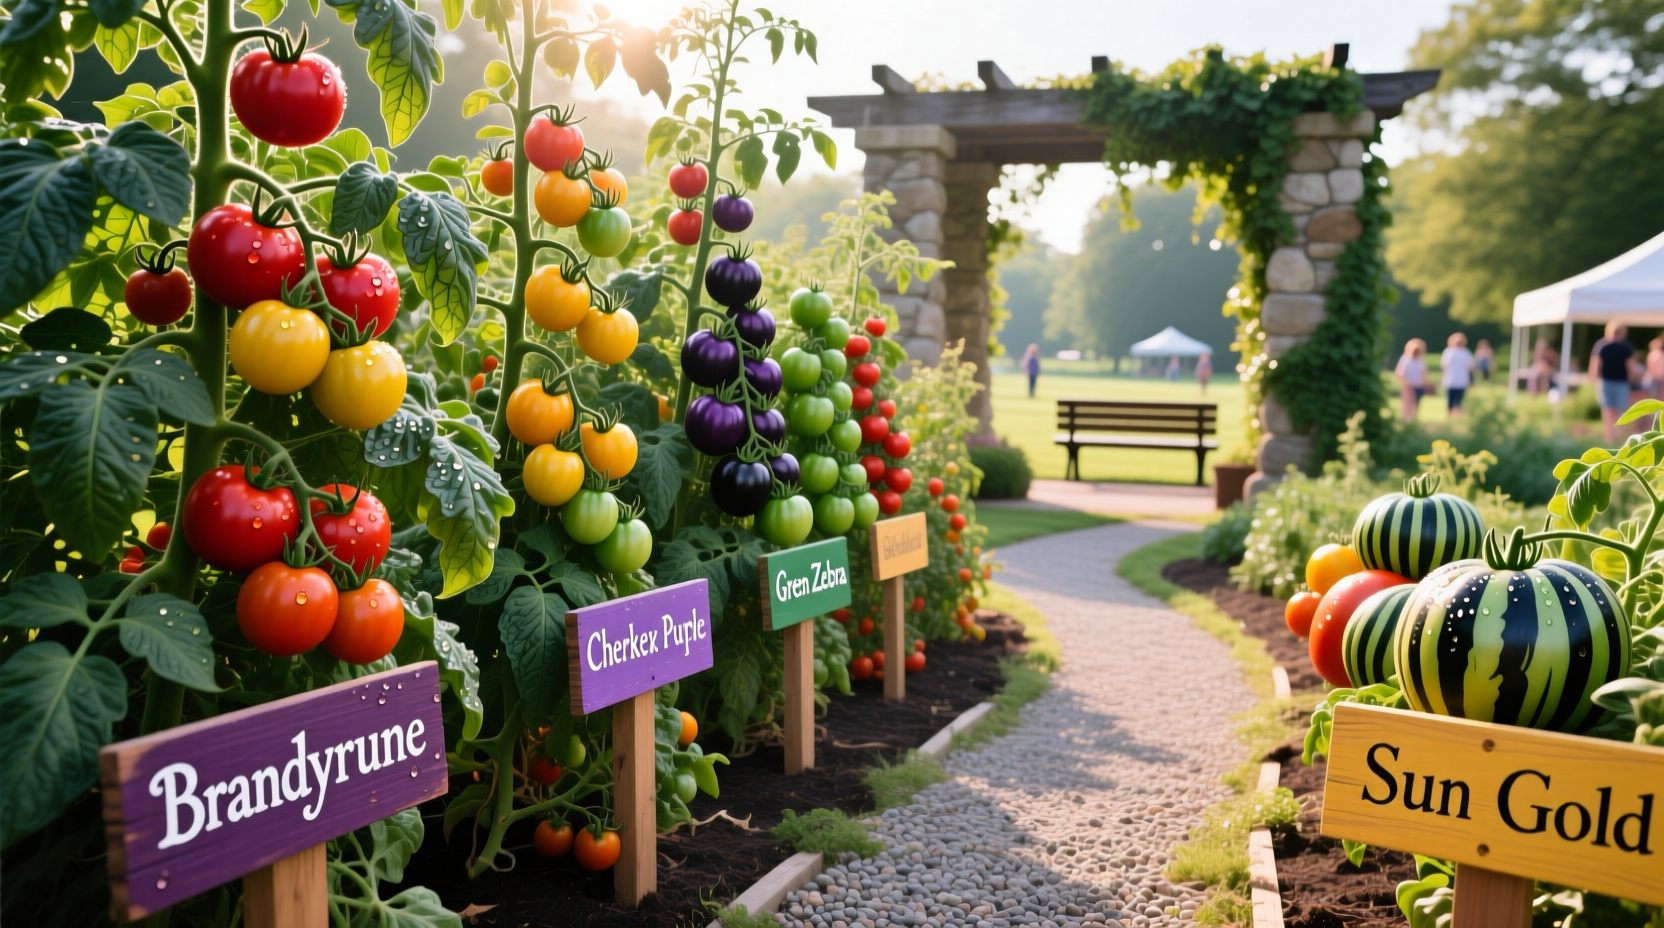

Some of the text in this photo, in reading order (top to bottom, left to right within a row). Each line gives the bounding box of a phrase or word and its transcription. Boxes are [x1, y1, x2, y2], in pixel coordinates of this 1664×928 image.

[776, 559, 848, 602] Gren Zebra
[587, 622, 659, 672] Cherkex
[149, 719, 427, 850] Brandyrune
[1362, 742, 1655, 855] Sun Gold
